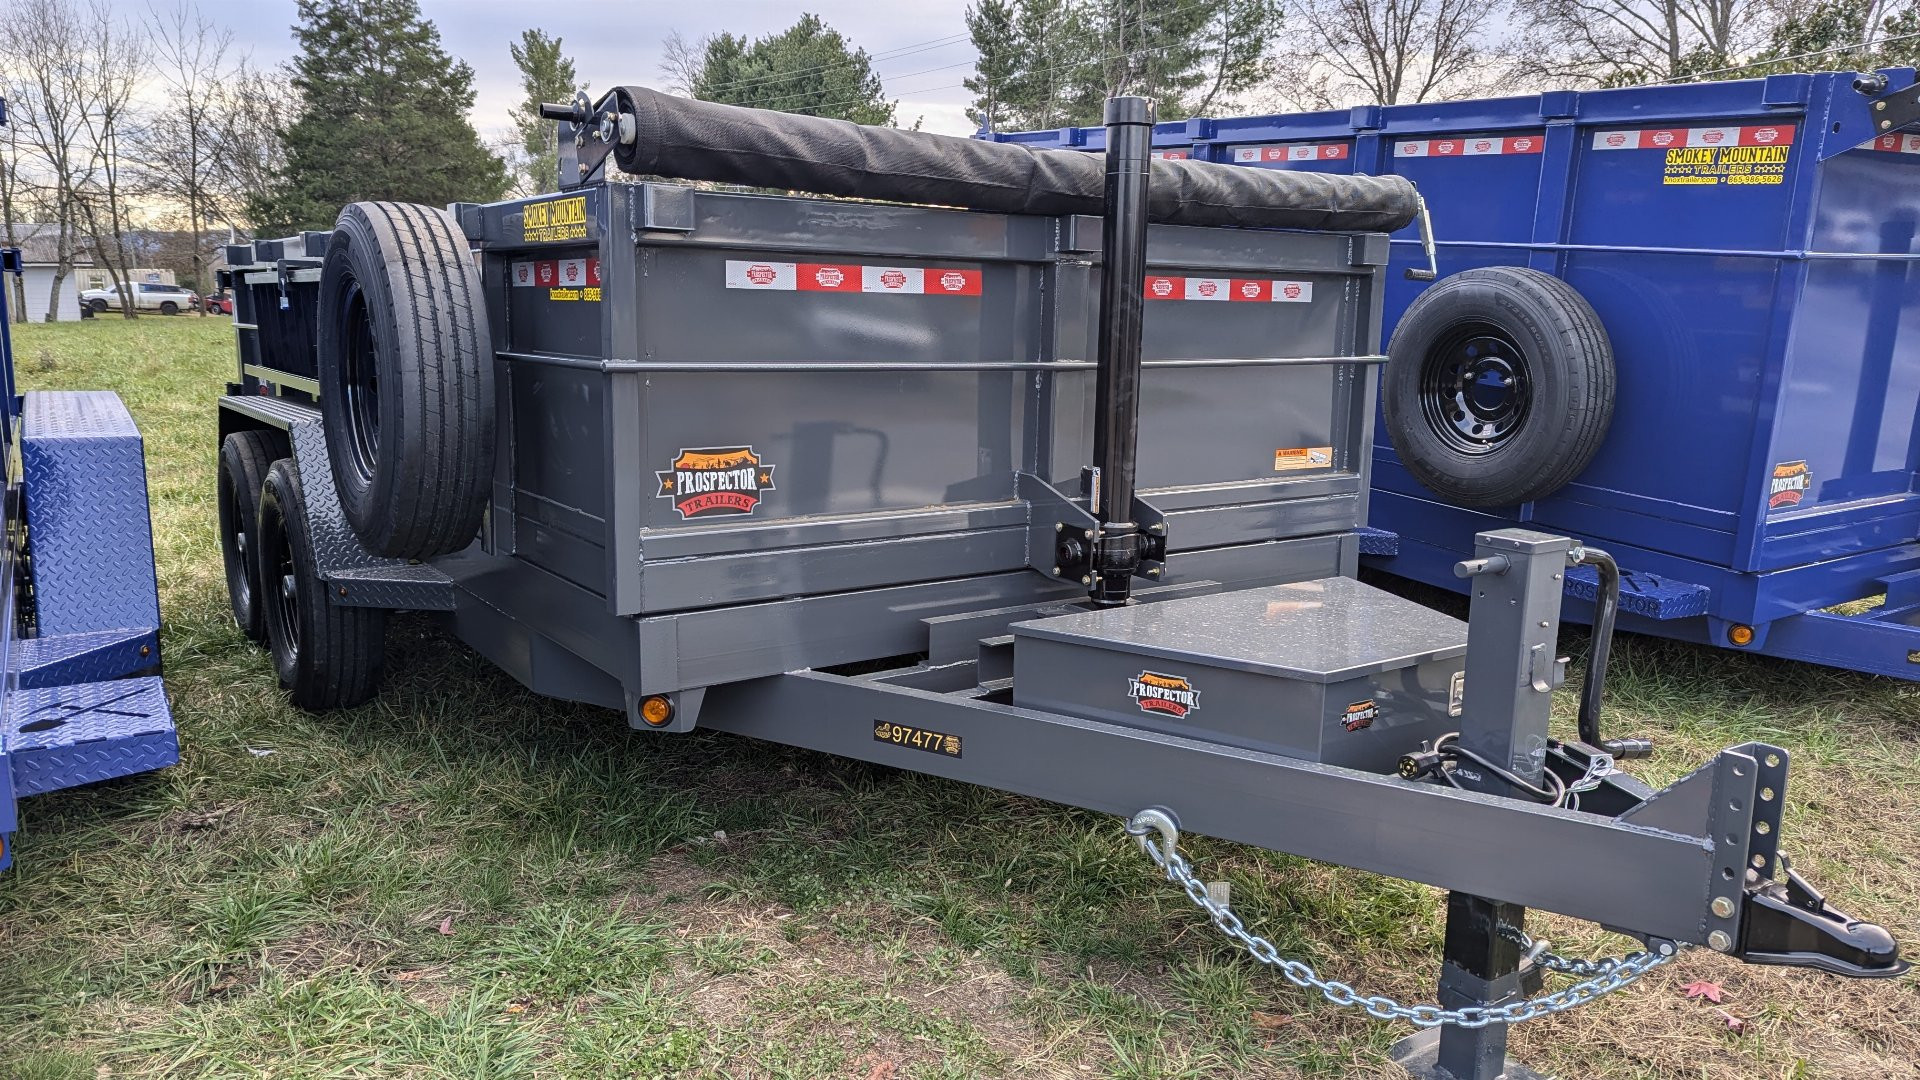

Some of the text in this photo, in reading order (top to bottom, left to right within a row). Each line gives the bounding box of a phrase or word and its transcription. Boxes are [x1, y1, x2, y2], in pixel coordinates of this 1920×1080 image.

[1666, 146, 1790, 165] SMOKEY MOUNTAIN
[1694, 165, 1752, 175] TRAILERS
[524, 197, 587, 229] SMOKEY MOUNTAIN
[540, 226, 570, 242] TRAILERS
[677, 467, 758, 496] PROSPECTOR
[686, 495, 750, 513] TRAILERS
[1133, 681, 1195, 706] PROSPECTOR
[1144, 700, 1184, 714] TRAILERS
[892, 725, 944, 751] 97477
